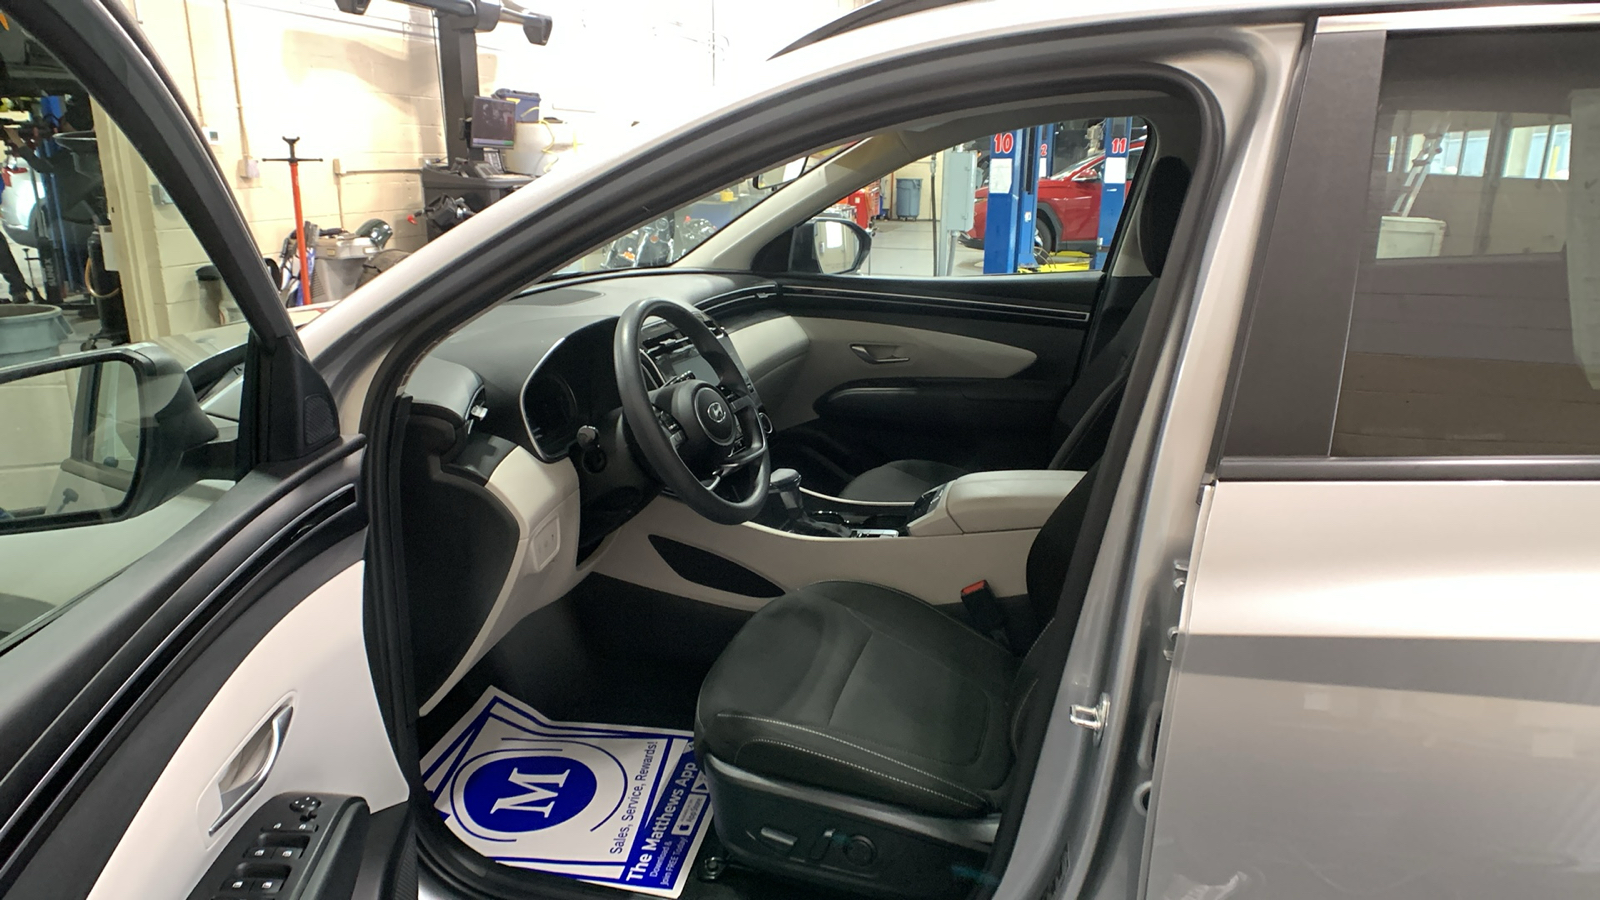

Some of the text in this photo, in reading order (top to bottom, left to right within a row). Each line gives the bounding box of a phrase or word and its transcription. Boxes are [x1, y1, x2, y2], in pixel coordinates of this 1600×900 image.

[994, 132, 1014, 154] 10
[1111, 138, 1127, 154] 11
[490, 767, 571, 818] M
[610, 741, 658, 854] Sales, Service, Rewards!
[626, 853, 652, 882] The
[641, 789, 685, 851] Matthews
[675, 762, 699, 788] App
[649, 846, 670, 878] Download
[665, 856, 679, 872] FREE
[660, 871, 671, 887] Join
